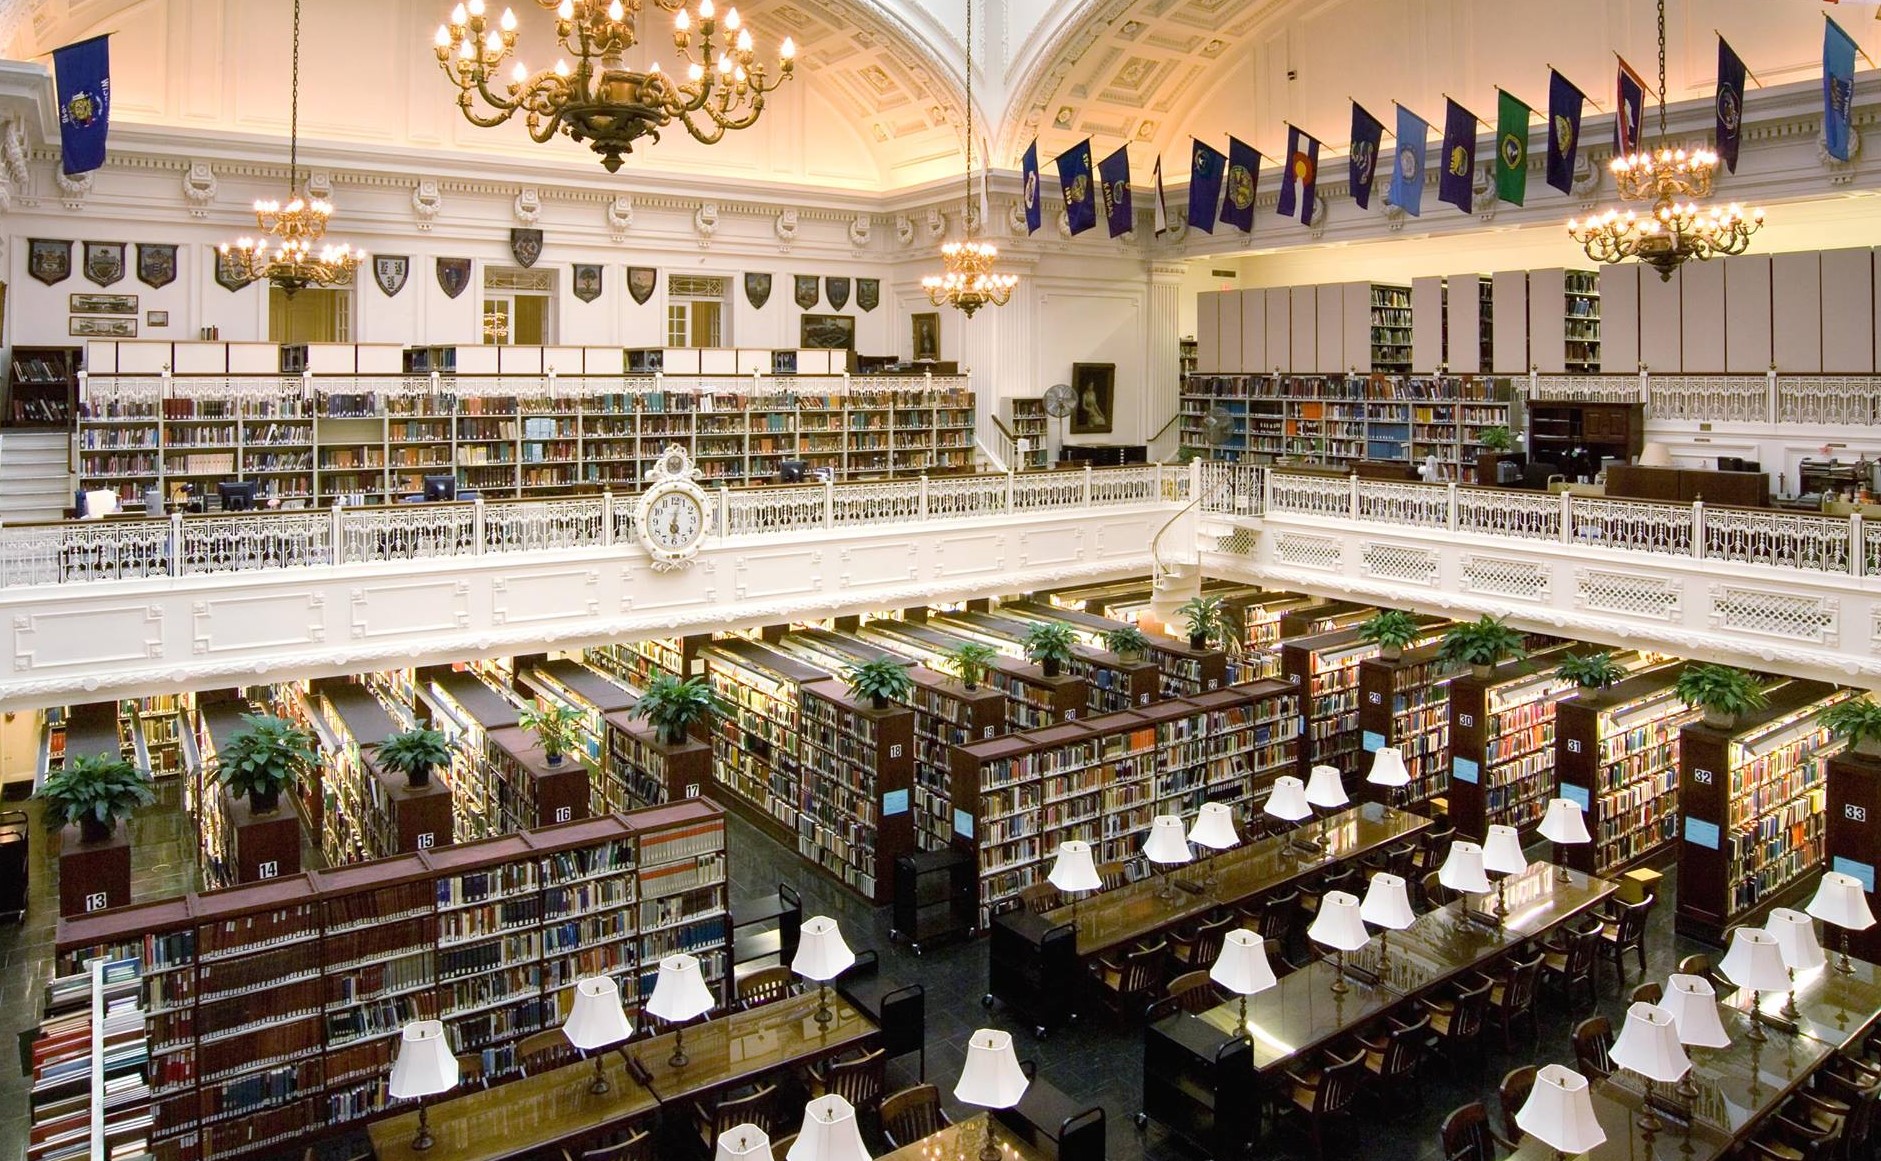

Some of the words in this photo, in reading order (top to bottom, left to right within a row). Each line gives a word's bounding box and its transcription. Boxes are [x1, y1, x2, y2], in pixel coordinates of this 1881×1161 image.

[1103, 182, 1113, 218] KANSAS
[1369, 692, 1381, 704] 29
[1065, 710, 1076, 721] 20
[1460, 714, 1472, 726] 30
[985, 727, 994, 738] 19
[891, 745, 901, 757] 18
[1568, 739, 1580, 752] 31
[1695, 769, 1711, 784] 32
[687, 784, 699, 797] 17
[557, 807, 570, 822] 16
[1846, 805, 1864, 821] 33
[418, 834, 433, 848] 15
[260, 862, 277, 878] 14
[87, 894, 105, 911] 13
